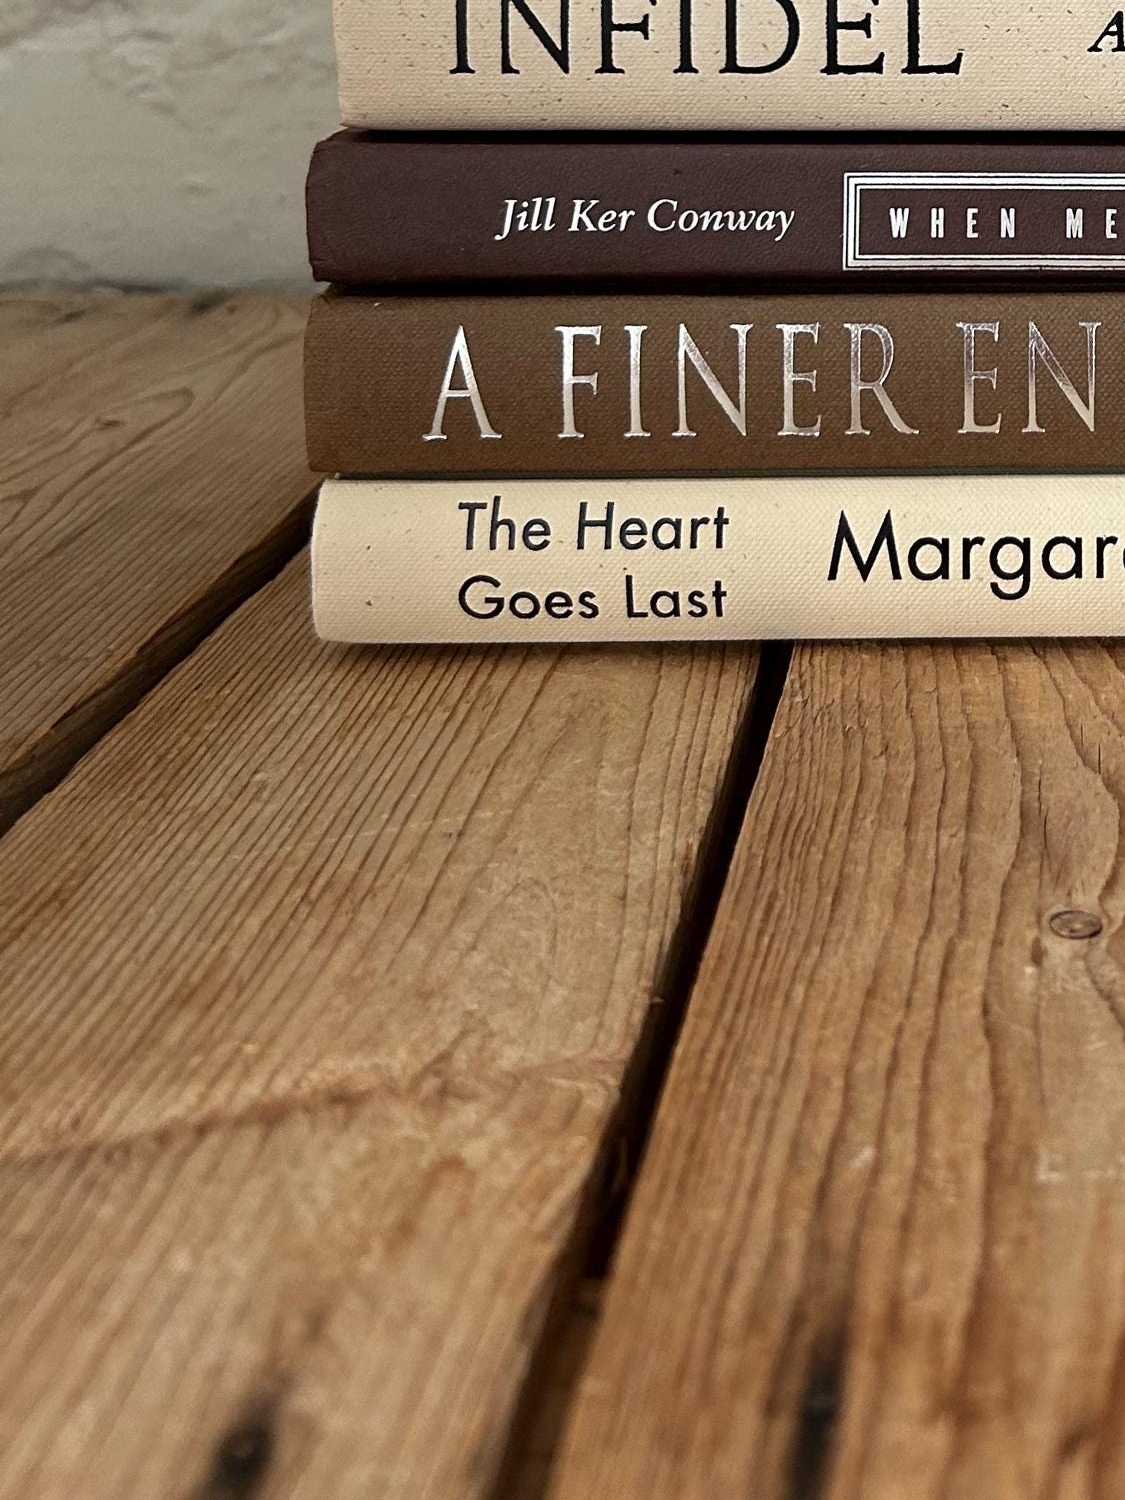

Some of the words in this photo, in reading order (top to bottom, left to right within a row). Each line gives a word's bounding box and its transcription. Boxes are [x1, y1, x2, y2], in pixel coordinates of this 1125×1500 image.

[494, 196, 556, 241] Jill
[568, 199, 636, 232] Ker
[647, 198, 795, 242] Conway
[889, 207, 1016, 239] WHEN
[422, 325, 502, 441] A
[554, 322, 920, 439] FINER
[457, 495, 551, 552] The
[576, 501, 730, 551] Heart
[457, 574, 600, 620] Goes
[625, 574, 727, 619] Last
